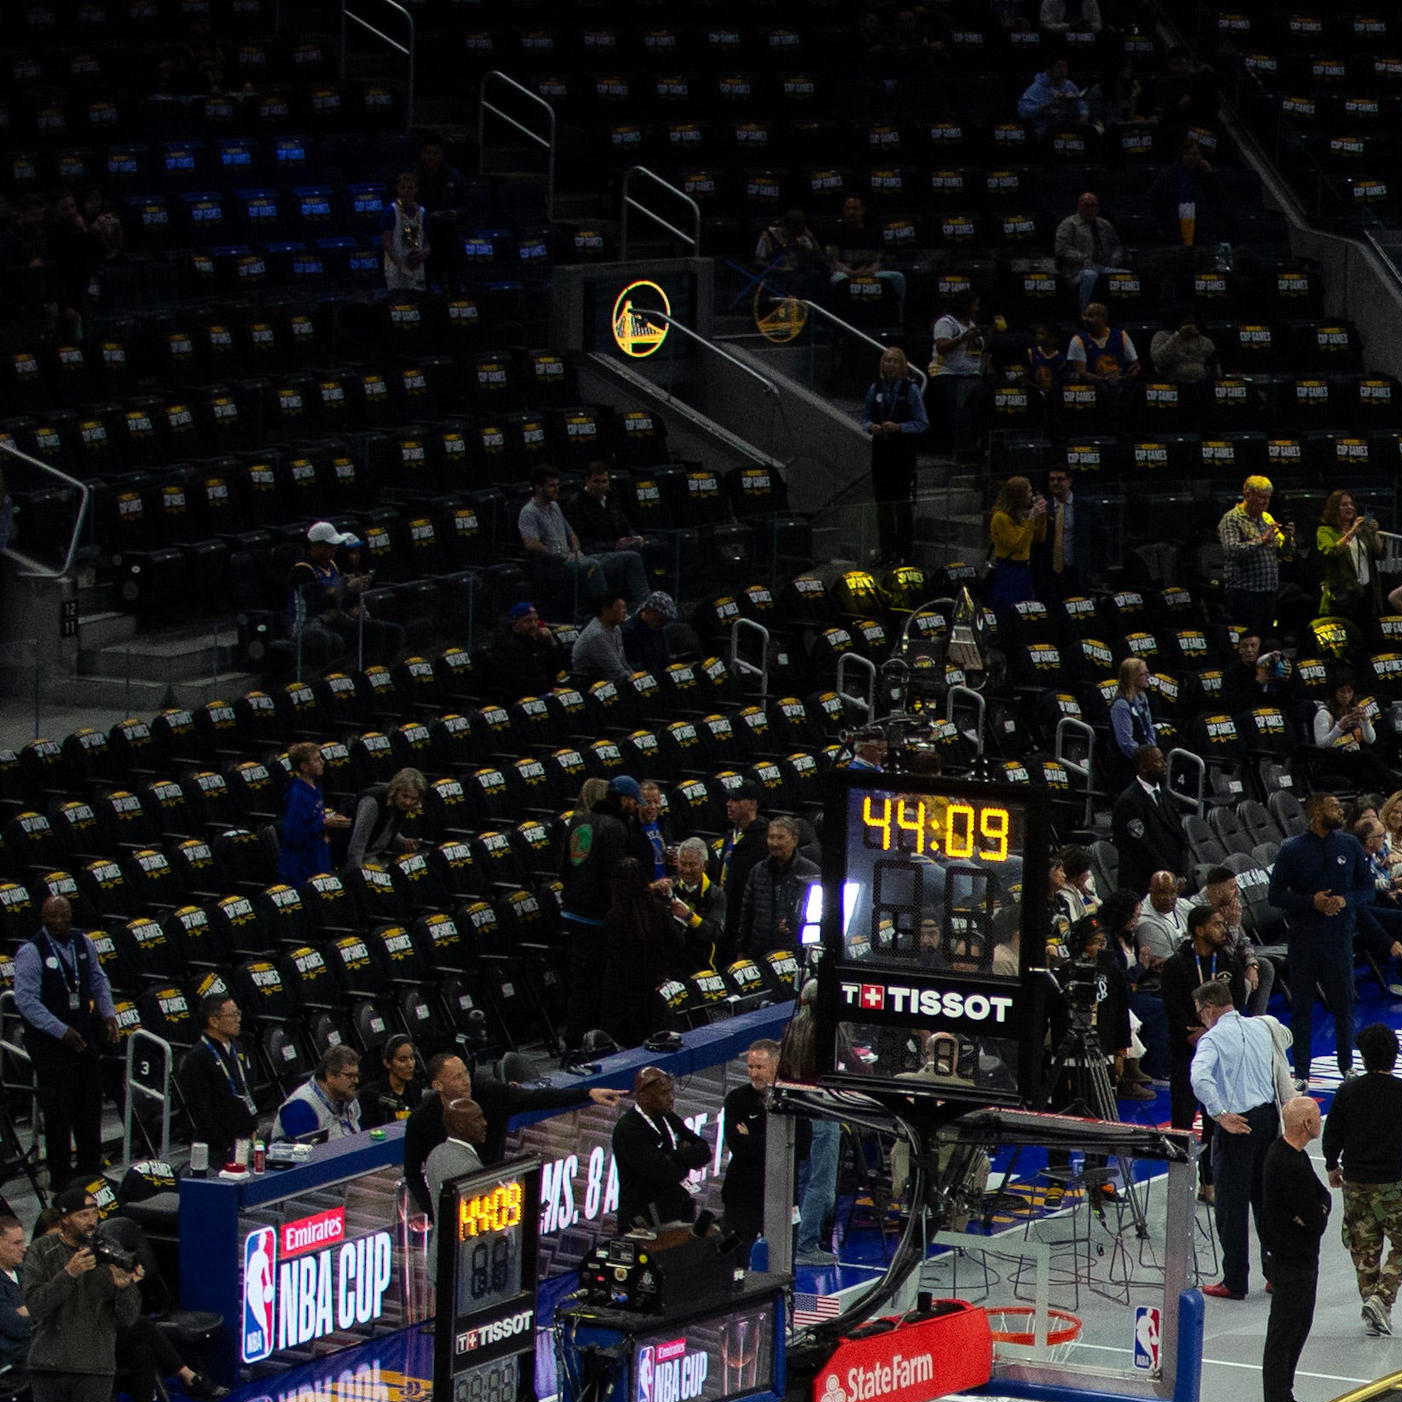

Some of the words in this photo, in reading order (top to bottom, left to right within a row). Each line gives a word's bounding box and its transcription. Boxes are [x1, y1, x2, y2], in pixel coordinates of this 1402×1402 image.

[1177, 773, 1186, 785] 4
[863, 796, 1010, 862] 44:09
[887, 986, 1014, 1023] TISSOT
[140, 1061, 150, 1076] 3
[584, 1146, 605, 1221] 8
[286, 1216, 342, 1251] Emirates
[278, 1250, 334, 1351] NBA
[338, 1231, 392, 1330] CUP
[478, 1311, 534, 1347] TISSOT
[681, 1351, 709, 1400] CUP
